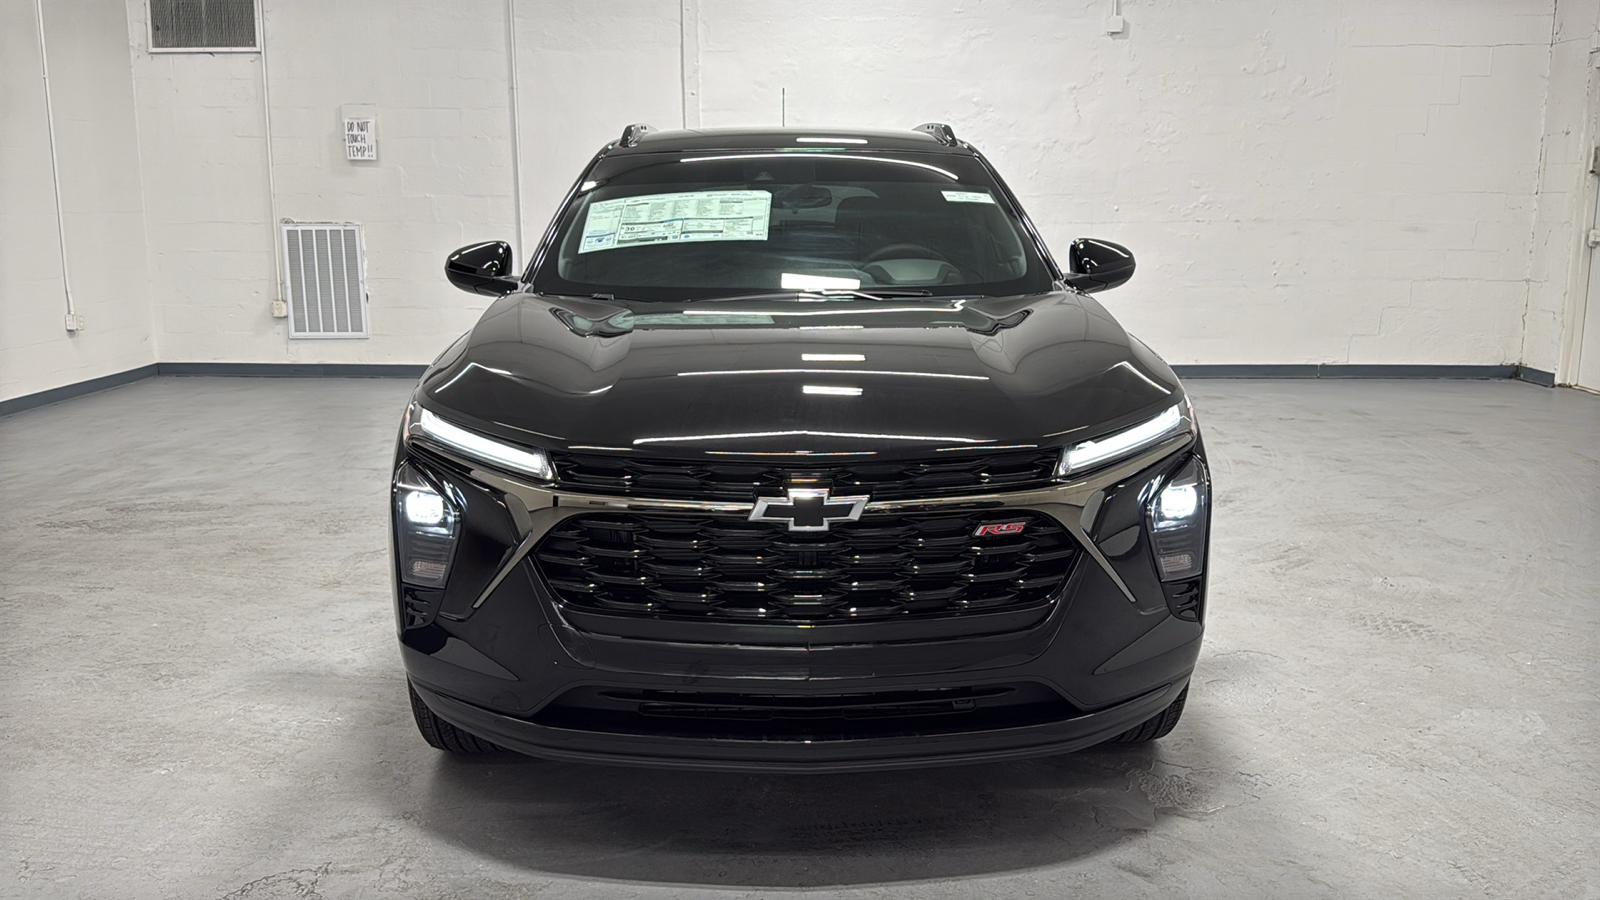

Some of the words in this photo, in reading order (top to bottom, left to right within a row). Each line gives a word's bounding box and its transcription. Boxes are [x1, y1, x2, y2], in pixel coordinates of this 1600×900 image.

[347, 121, 355, 132] DO
[357, 121, 370, 133] NOT
[346, 133, 366, 144] TOUCH
[347, 144, 373, 158] TEMP!!
[975, 522, 1026, 536] RS
